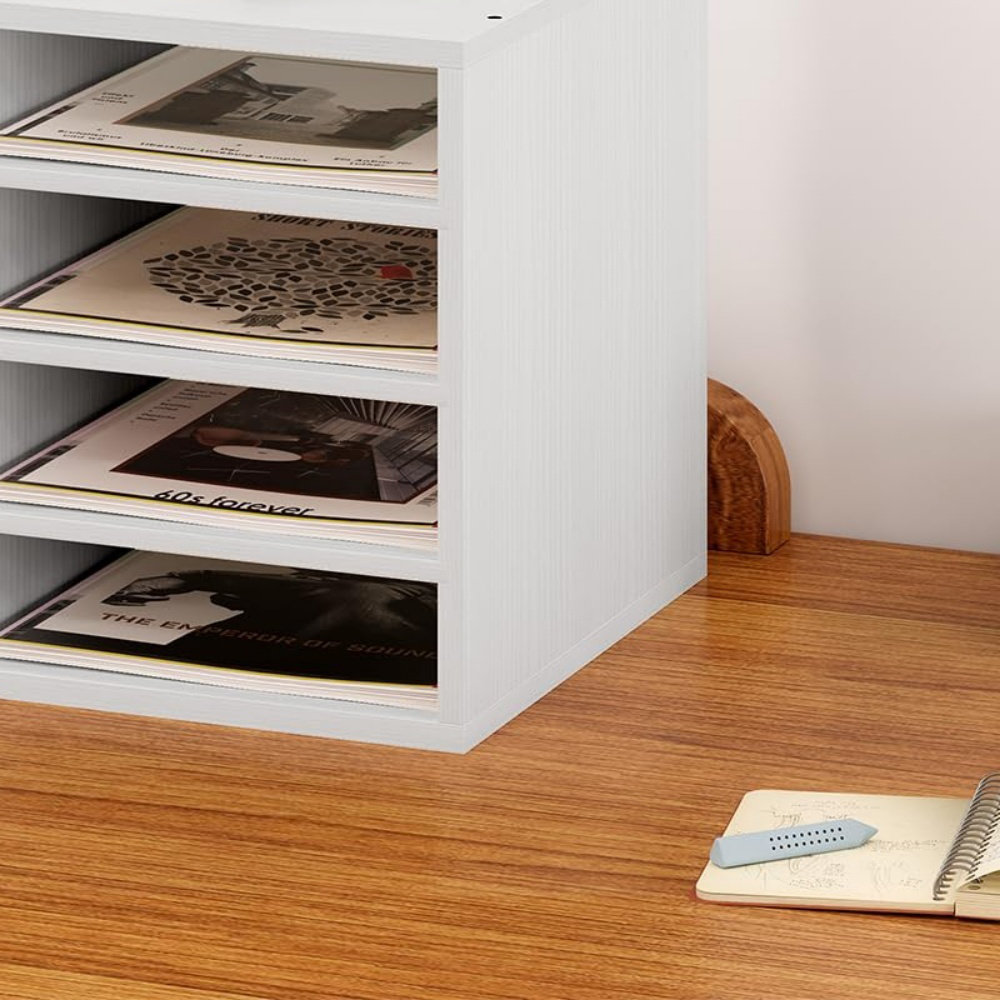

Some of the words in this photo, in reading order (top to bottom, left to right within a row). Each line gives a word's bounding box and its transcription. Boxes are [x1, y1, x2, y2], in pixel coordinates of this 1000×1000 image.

[252, 212, 332, 228] SHORT
[153, 489, 204, 505] 60s
[209, 495, 314, 517] forever
[100, 612, 157, 627] THE
[159, 620, 298, 646] EMPEROR
[302, 638, 342, 649] OF
